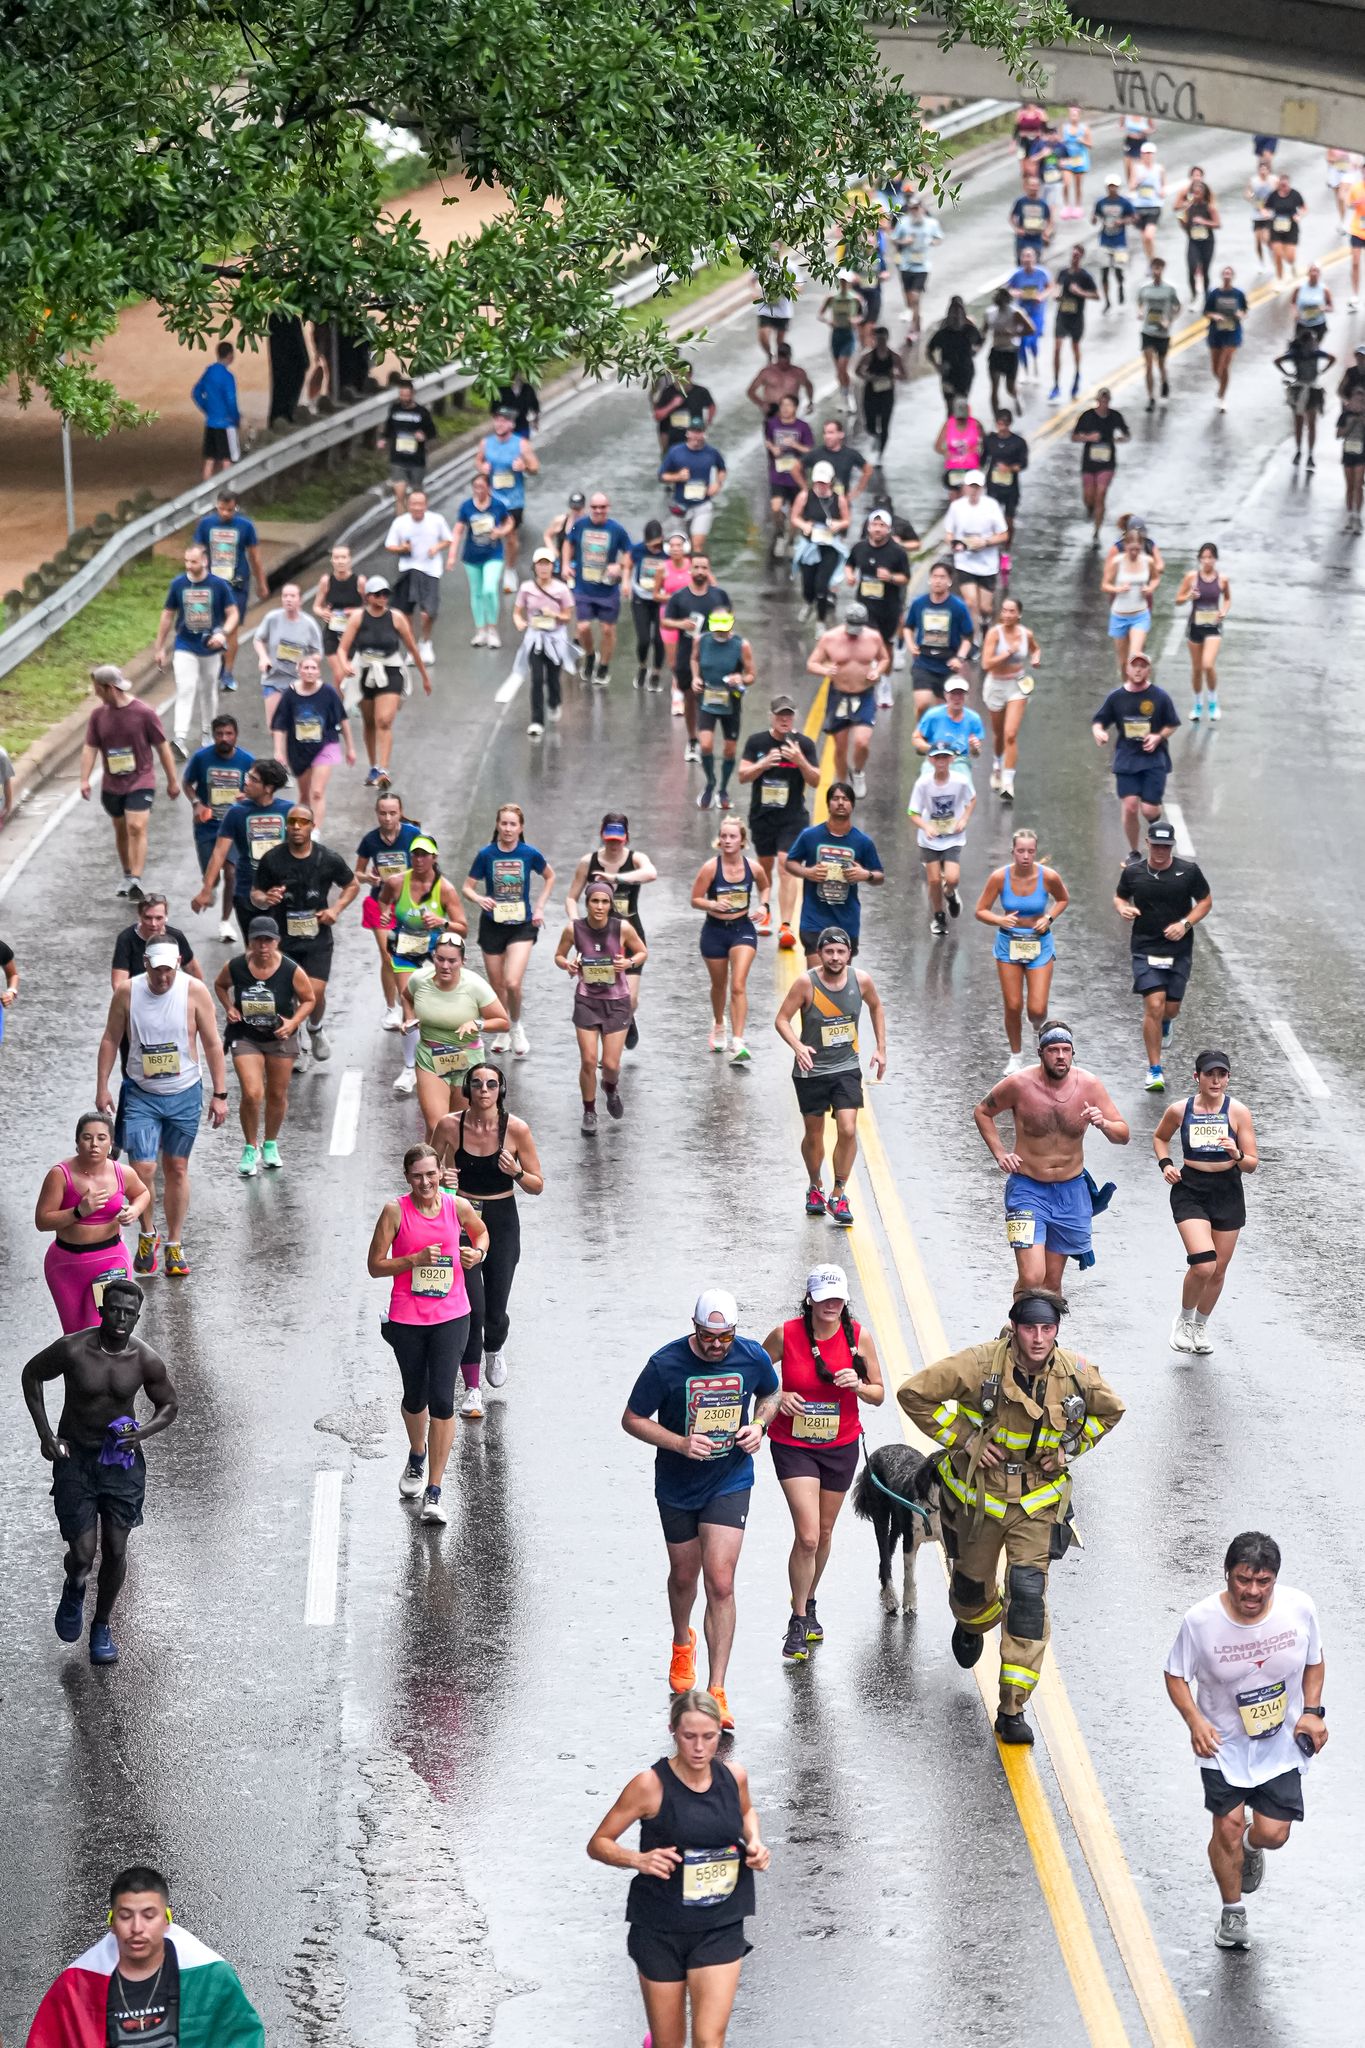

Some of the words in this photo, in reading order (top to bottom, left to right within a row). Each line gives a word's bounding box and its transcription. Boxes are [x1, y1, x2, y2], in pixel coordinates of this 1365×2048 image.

[829, 1025, 849, 1036] 2075
[148, 1054, 174, 1064] 16872
[439, 1054, 460, 1065] 9427
[1194, 1126, 1224, 1136] 20654
[420, 1269, 446, 1279] 6920
[703, 1408, 736, 1420] 23061
[803, 1417, 830, 1428] 12811
[1213, 1629, 1298, 1654] LONGHORN
[1219, 1639, 1296, 1663] AQUATICS
[1250, 1698, 1282, 1719] 23141
[696, 1863, 727, 1881] 5588
